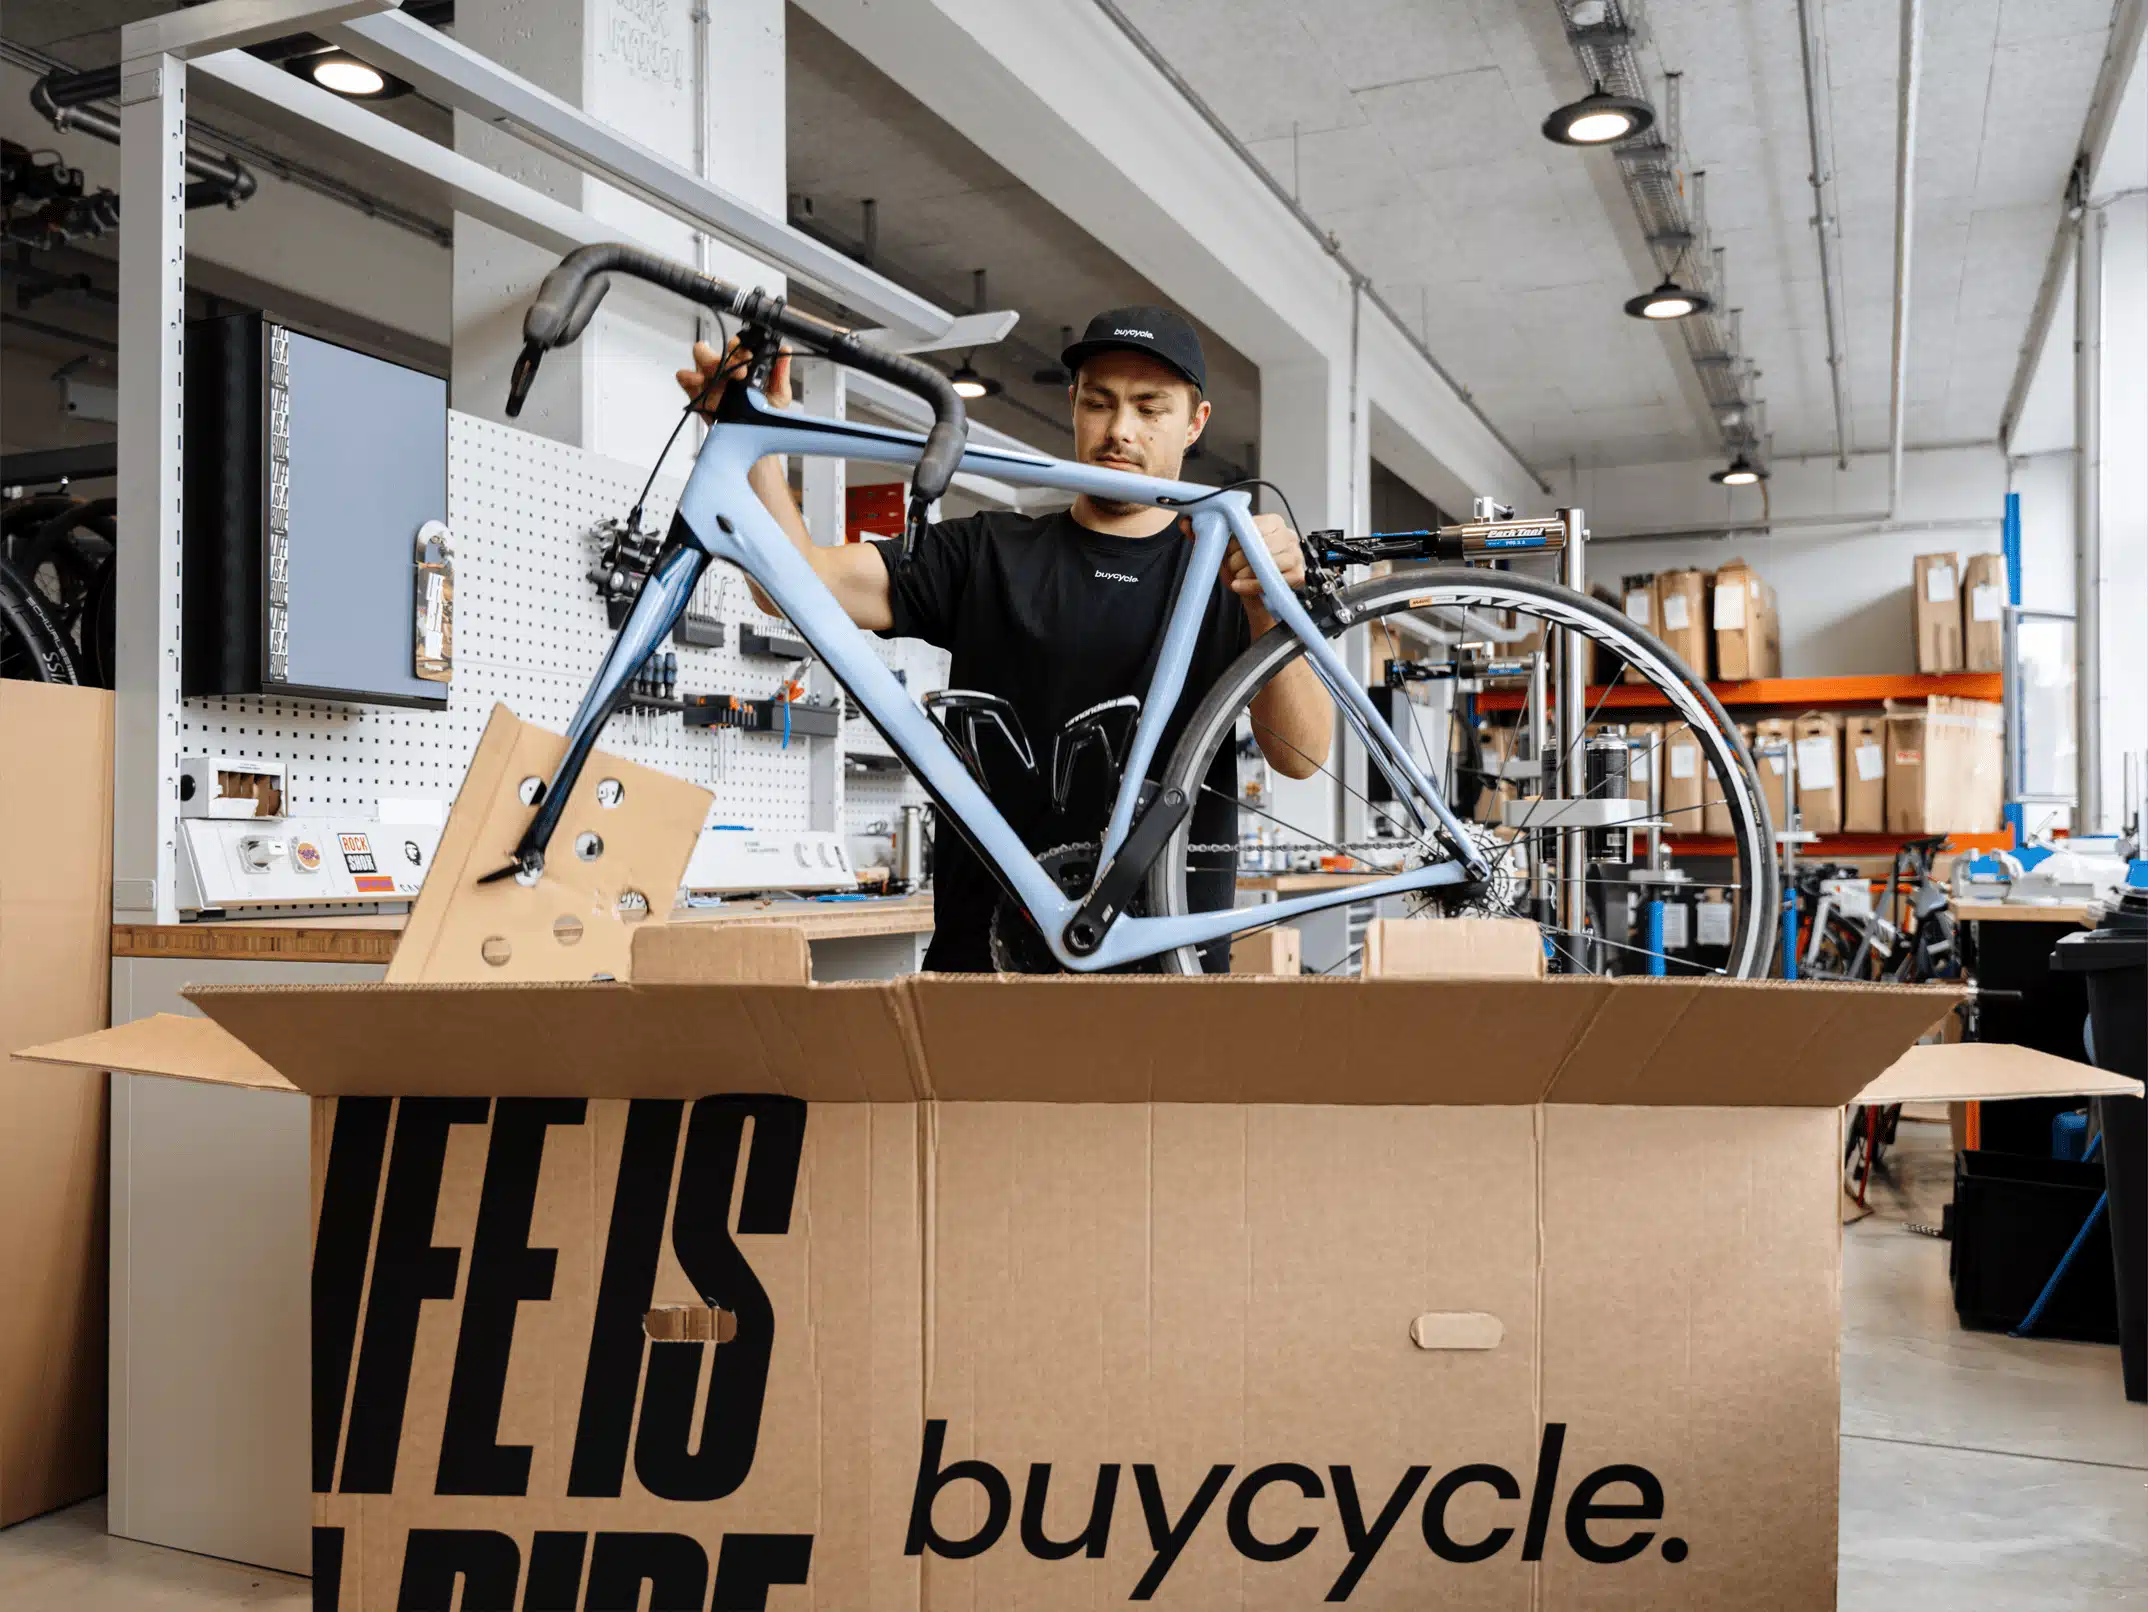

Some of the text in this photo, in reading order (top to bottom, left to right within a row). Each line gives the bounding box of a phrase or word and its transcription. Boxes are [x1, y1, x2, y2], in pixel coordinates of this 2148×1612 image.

[273, 412, 282, 434] IS
[272, 485, 282, 506] IS
[272, 558, 281, 580] IS
[272, 631, 281, 652] IS
[342, 836, 368, 852] ROCK
[349, 854, 375, 871] SHOX
[567, 1094, 808, 1502] IS
[904, 1420, 1689, 1602] buycycle.
